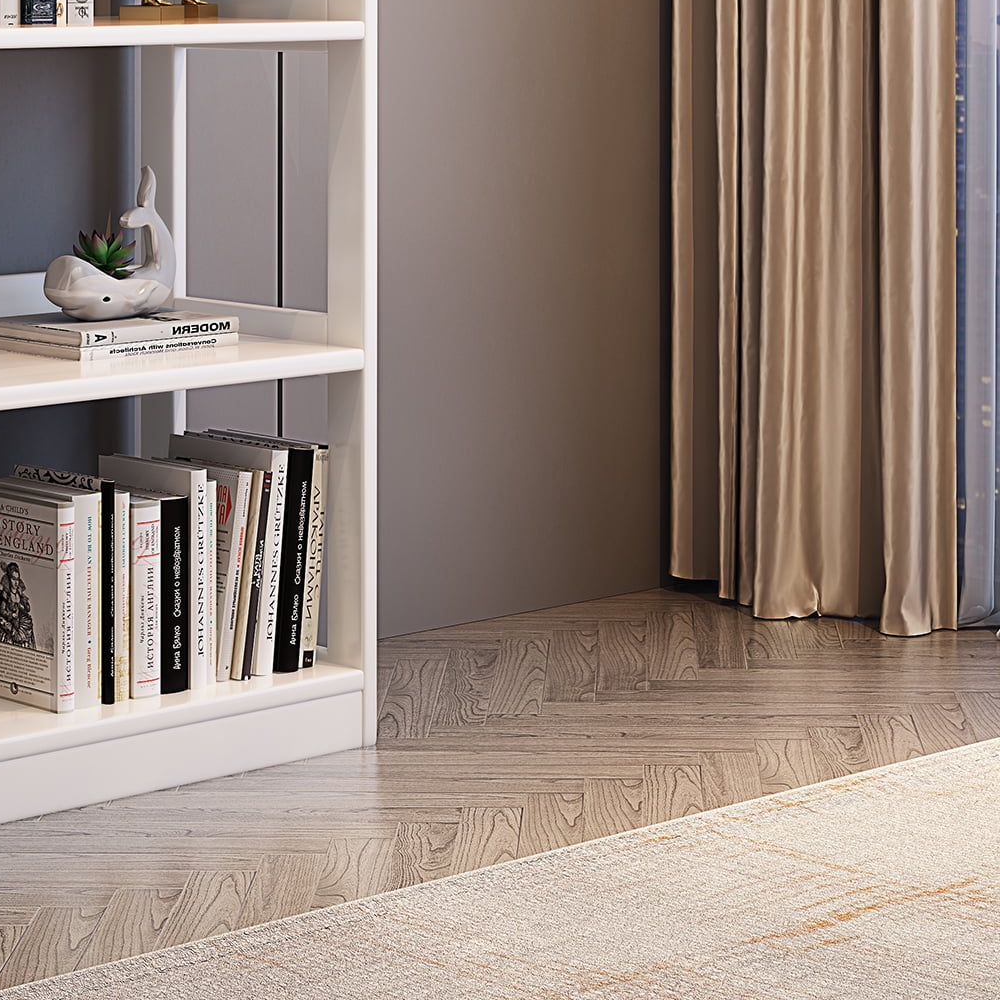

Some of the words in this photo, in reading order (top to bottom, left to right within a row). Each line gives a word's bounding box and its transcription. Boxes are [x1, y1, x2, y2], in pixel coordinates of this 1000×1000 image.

[0, 503, 4, 511] A
[5, 504, 29, 515] CHILD'S
[87, 534, 92, 543] TO
[87, 544, 92, 554] BE
[172, 526, 182, 579] невозвратном
[87, 555, 92, 565] AN
[289, 624, 297, 646] Анна
[294, 552, 302, 585] Сказки
[298, 480, 308, 541] невозвратном
[172, 589, 182, 618] Сказки
[266, 549, 278, 642] JOHANNES
[172, 651, 181, 670] Анна
